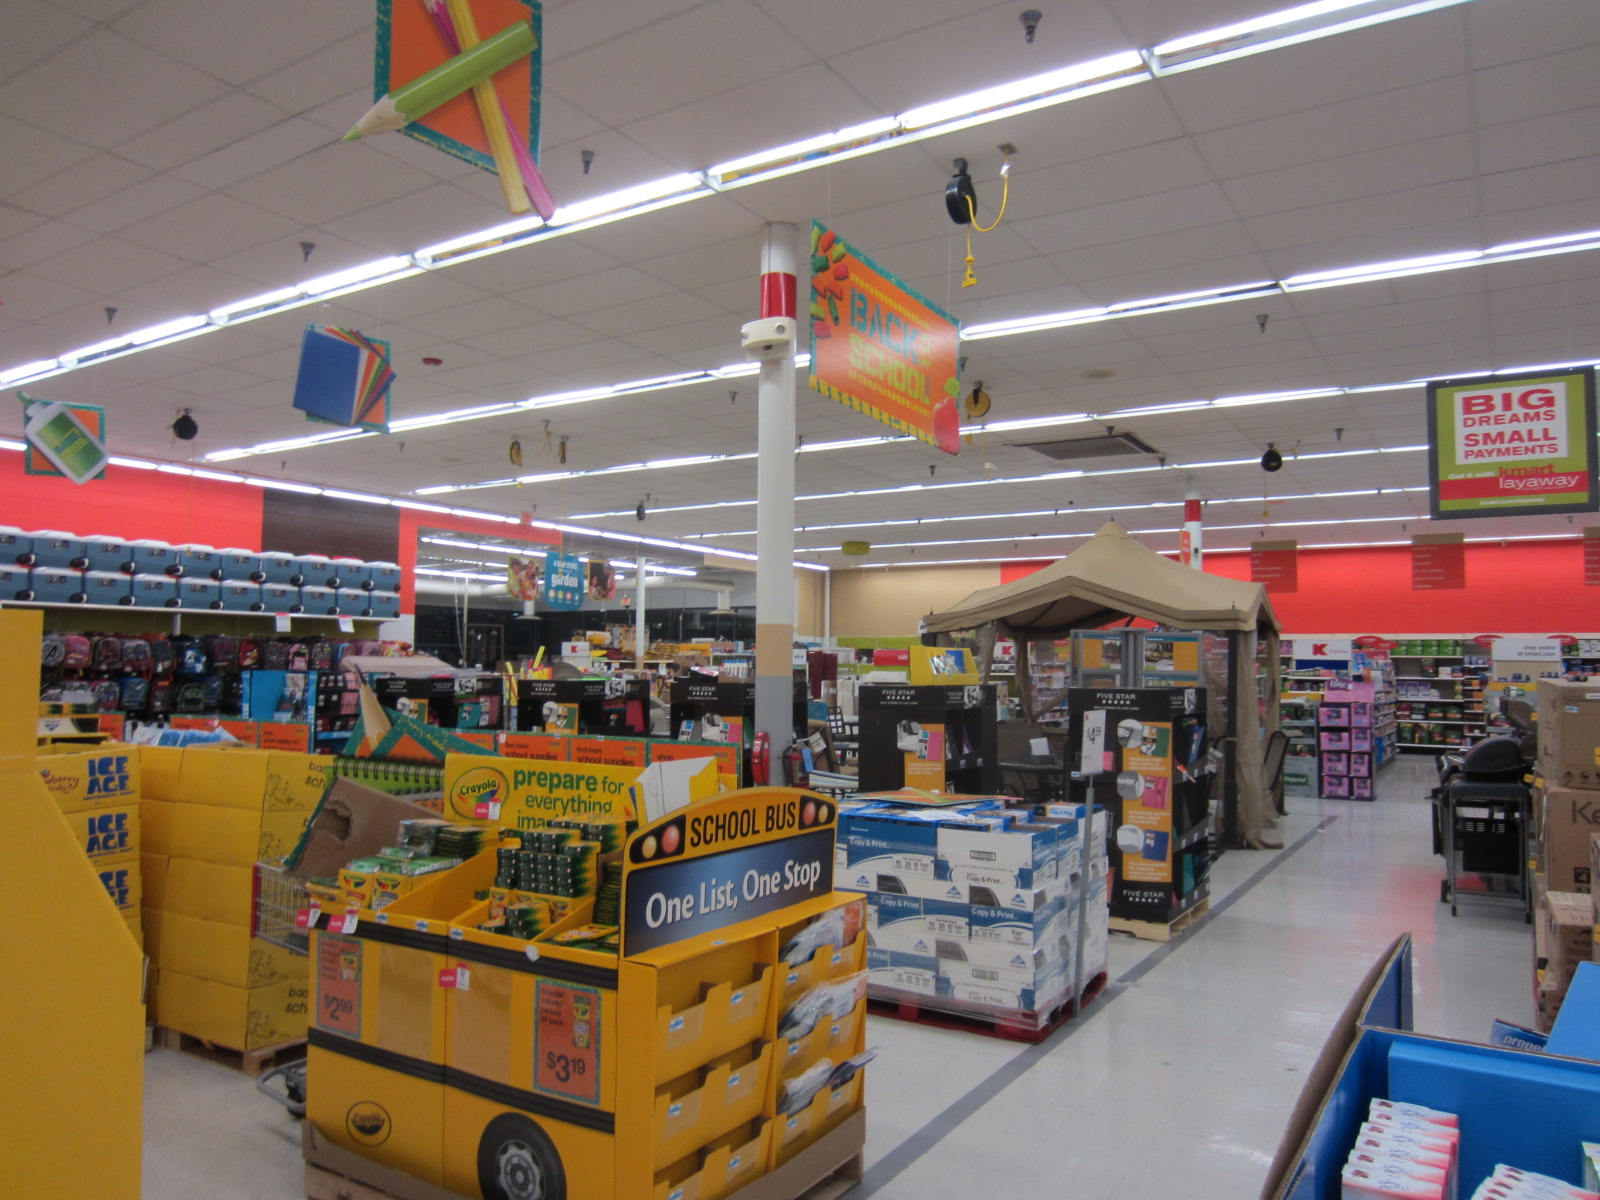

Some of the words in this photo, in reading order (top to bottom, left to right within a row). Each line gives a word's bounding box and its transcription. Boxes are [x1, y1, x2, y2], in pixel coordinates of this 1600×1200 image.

[851, 288, 919, 364] BACK
[850, 333, 931, 405] SCHOOL
[1462, 389, 1555, 415] BIG
[1463, 410, 1556, 428] DREAMS
[1463, 428, 1557, 447] SMALL
[1464, 444, 1558, 459] PAYMENTS
[1498, 463, 1555, 477] kmart
[1500, 475, 1579, 491] layaway
[551, 573, 578, 588] garden
[530, 752, 558, 760] supplies
[604, 758, 634, 766] supplies
[88, 756, 128, 777] ICE
[87, 775, 130, 794] AGE
[460, 780, 497, 796] Crayola
[512, 769, 598, 793] prepare
[602, 776, 625, 794] for
[1284, 776, 1306, 784] Depend
[525, 792, 612, 814] everything
[88, 814, 128, 835] ICE
[518, 810, 545, 829] ima
[690, 808, 760, 848] SCHOOL
[765, 802, 796, 832] BUS
[86, 832, 129, 853] AGE
[850, 839, 864, 847] Copy
[645, 892, 694, 929] One
[700, 878, 738, 916] List,
[742, 869, 781, 902] One
[784, 860, 821, 892] Stop
[881, 898, 896, 907] Copy
[903, 900, 920, 909] Print
[972, 907, 988, 917] Copy
[996, 910, 1014, 920] Print
[872, 952, 888, 960] Print
[968, 992, 982, 1001] Copy
[353, 1112, 382, 1126] Crayola
